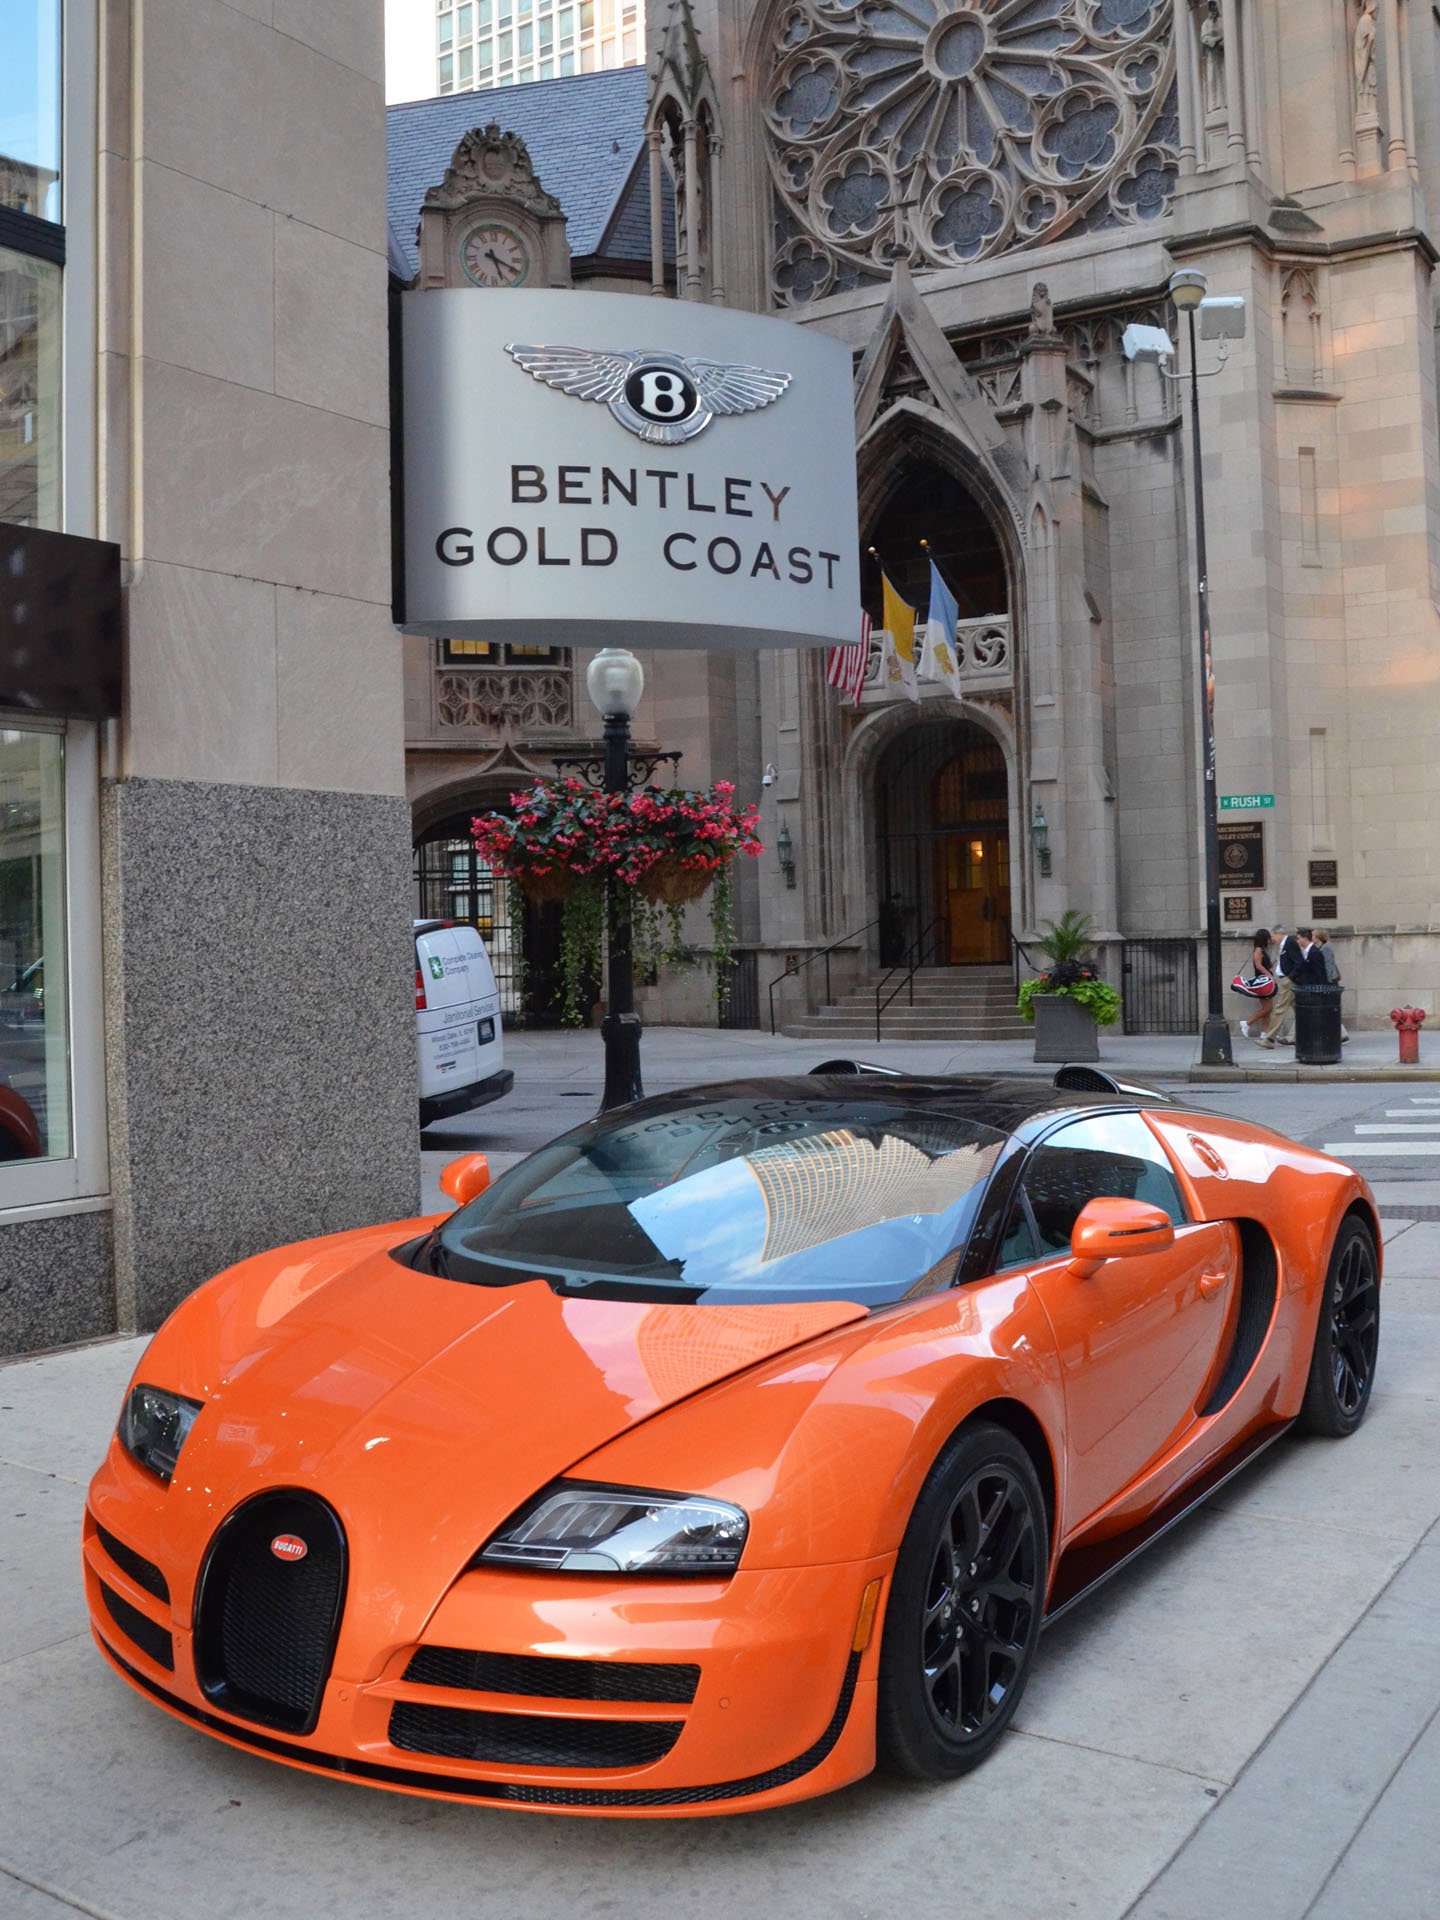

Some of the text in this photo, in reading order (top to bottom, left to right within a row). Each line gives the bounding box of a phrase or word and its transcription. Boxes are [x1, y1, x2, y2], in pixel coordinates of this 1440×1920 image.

[511, 464, 792, 522] BENTLEY
[435, 526, 841, 590] GOLD COAST
[1231, 797, 1260, 808] RUSH
[1228, 898, 1247, 909] 835
[442, 955, 466, 965] Complete
[445, 965, 469, 975] Company
[443, 1003, 494, 1023] Janitorial Services
[274, 1541, 303, 1555] BUGATTI
